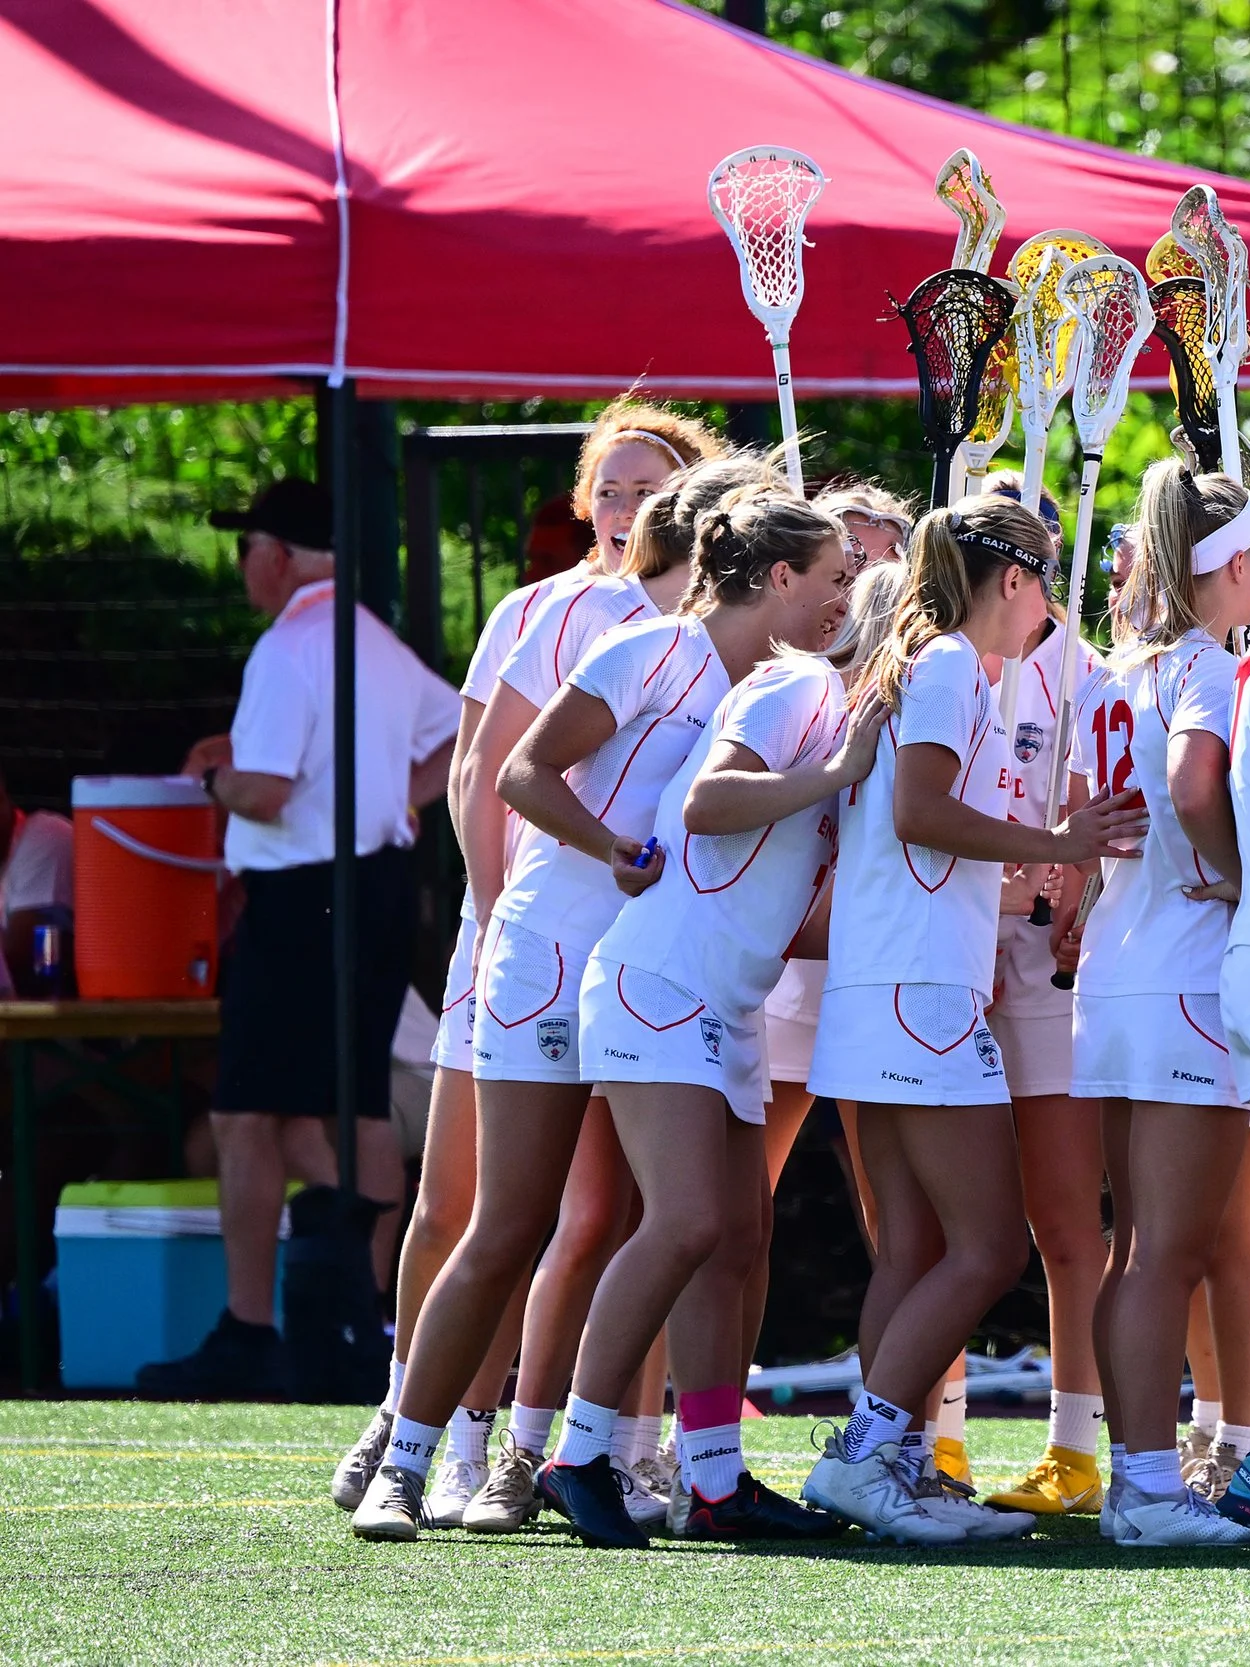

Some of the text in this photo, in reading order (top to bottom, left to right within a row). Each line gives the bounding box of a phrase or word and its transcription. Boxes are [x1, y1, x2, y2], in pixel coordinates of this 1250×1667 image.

[982, 536, 1011, 552] GAIT
[1015, 548, 1040, 567] GAIT
[1092, 698, 1148, 811] 12
[610, 1048, 640, 1061] KUKRI
[888, 1072, 923, 1085] KUKRI
[1180, 1071, 1215, 1085] KUKRI
[691, 1446, 739, 1462] adidas
